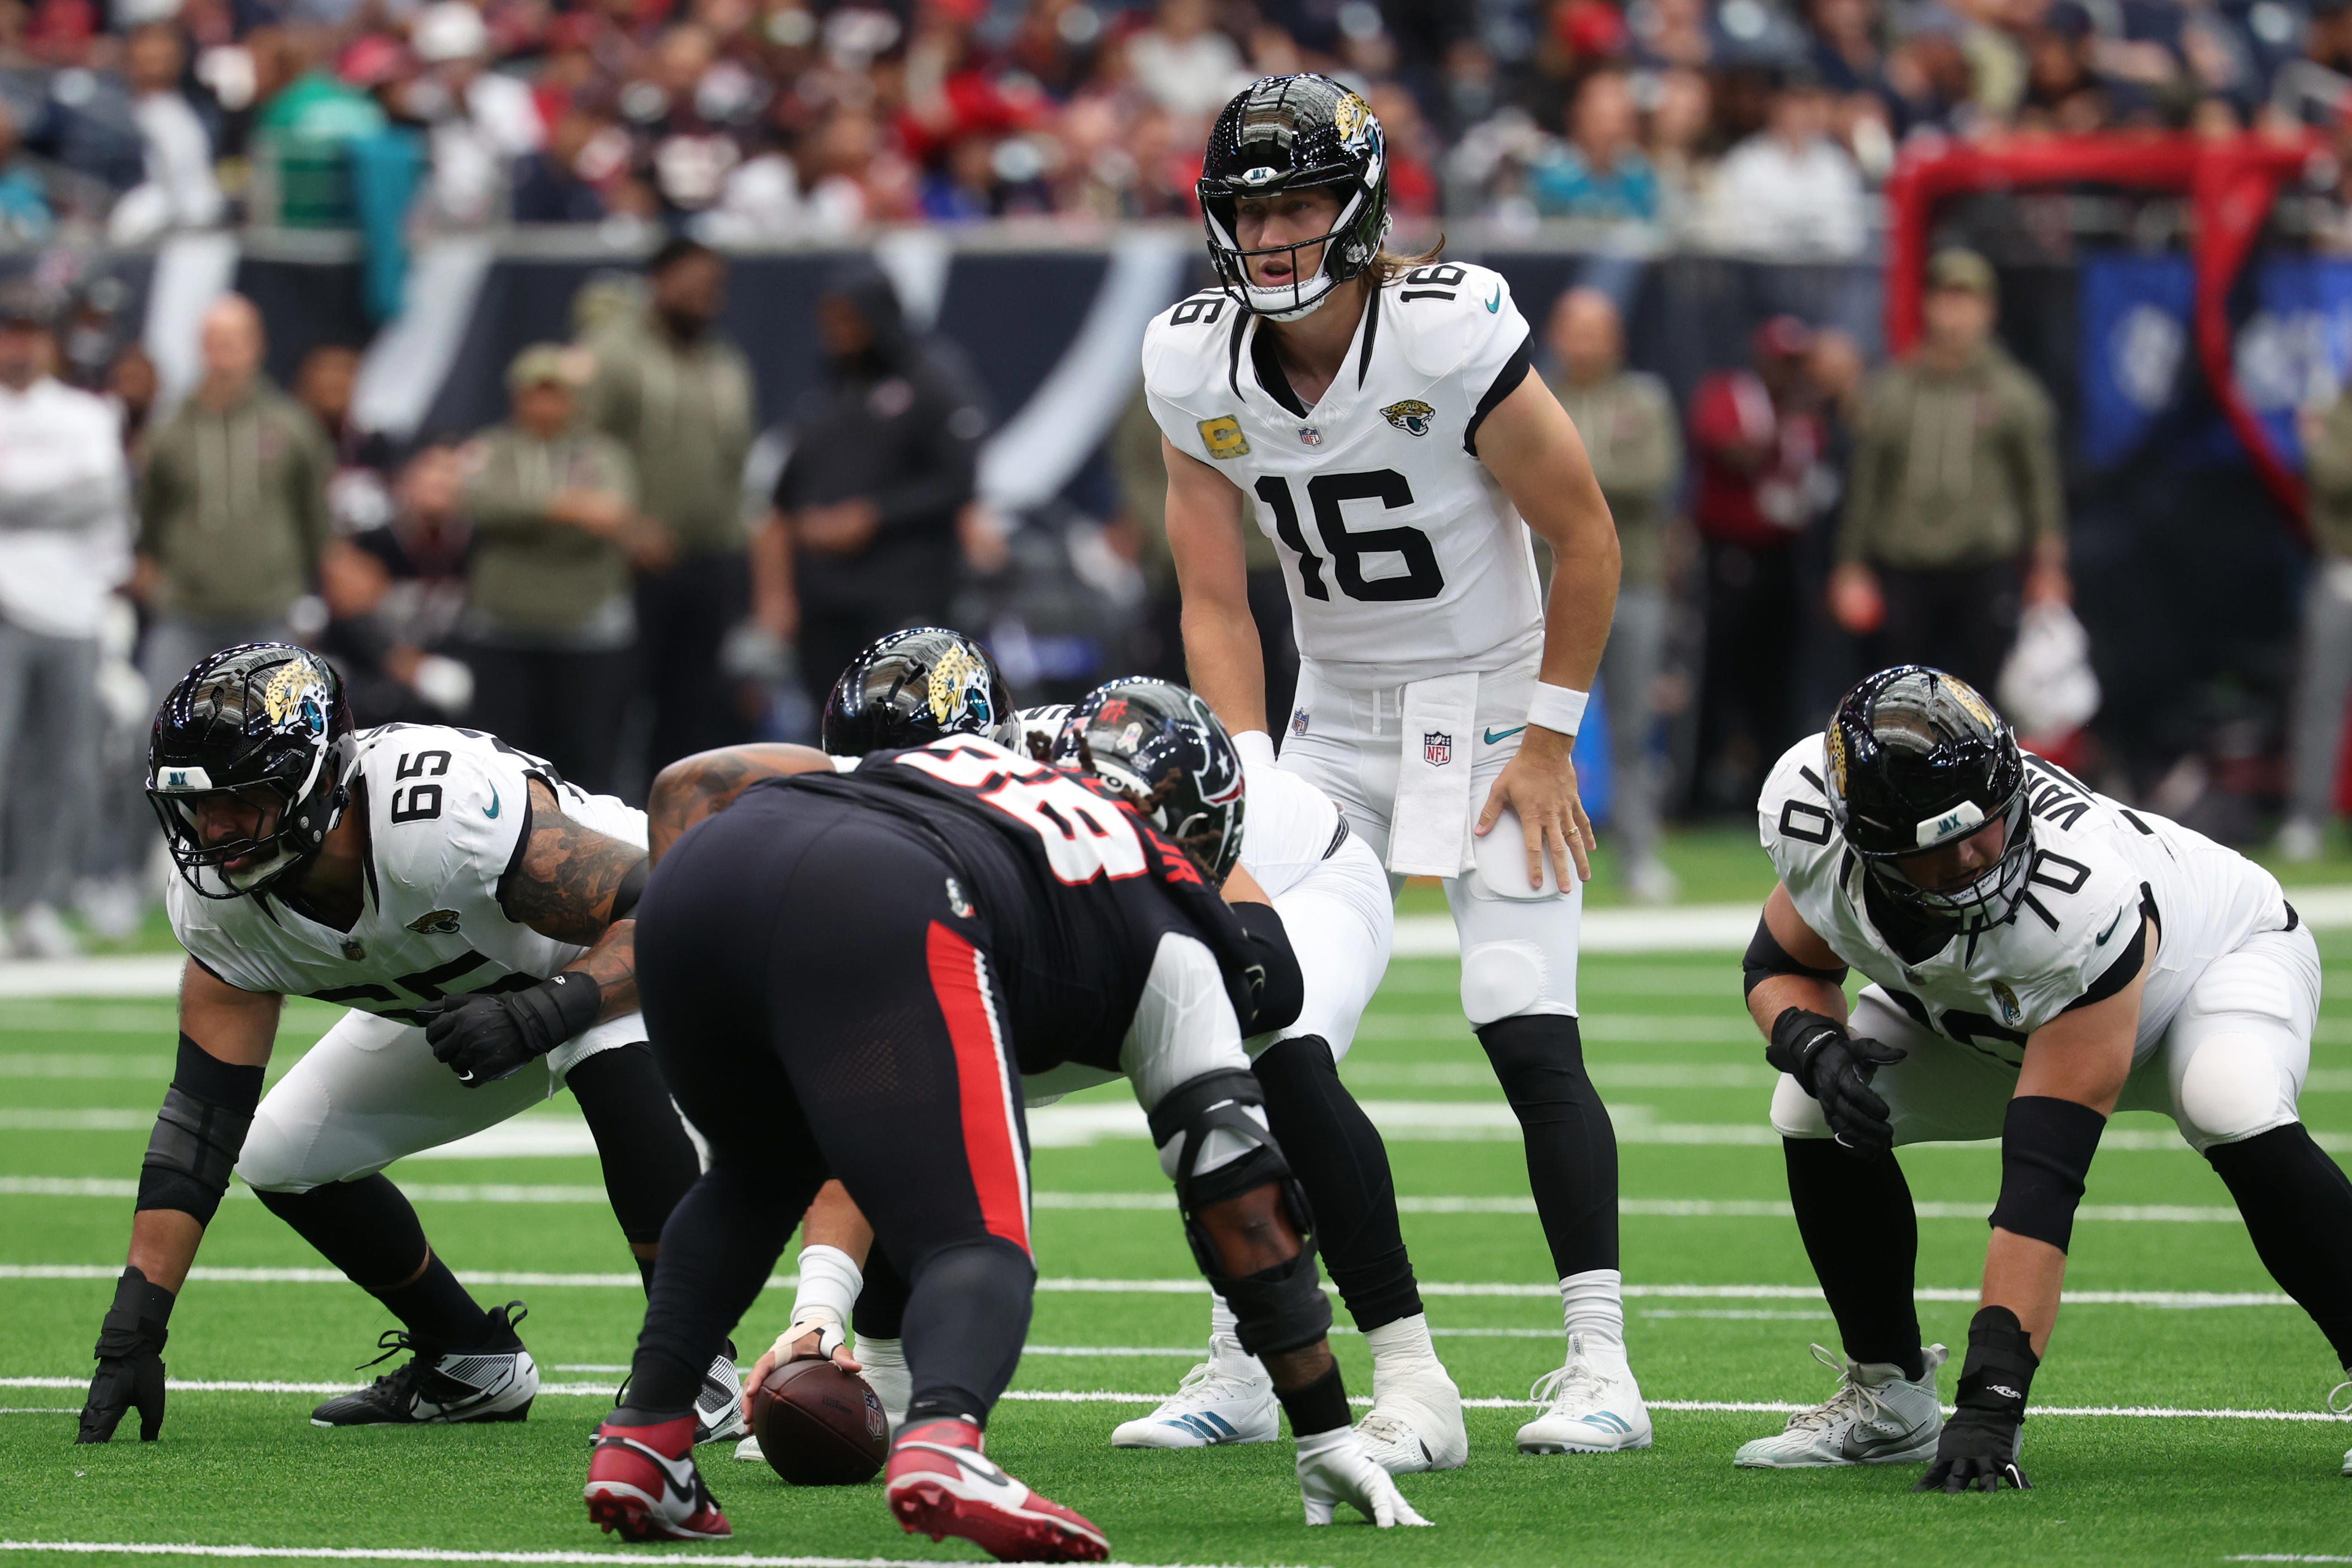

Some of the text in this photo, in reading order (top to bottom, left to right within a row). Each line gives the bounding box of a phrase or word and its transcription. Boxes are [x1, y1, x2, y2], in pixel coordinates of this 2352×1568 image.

[1251, 168, 1267, 180] JAX
[1400, 264, 1467, 302] 16
[1202, 419, 1241, 450] C
[1303, 435, 1319, 444] NFL
[1254, 468, 1445, 601] 16
[1293, 719, 1304, 731] NFL
[1427, 746, 1447, 762] NFL
[168, 772, 188, 785] JAX
[391, 750, 452, 824] 65
[1937, 813, 1961, 835] JAX
[1144, 828, 1203, 885] JR
[2004, 849, 2091, 932] 70
[868, 1409, 883, 1435] NFL
